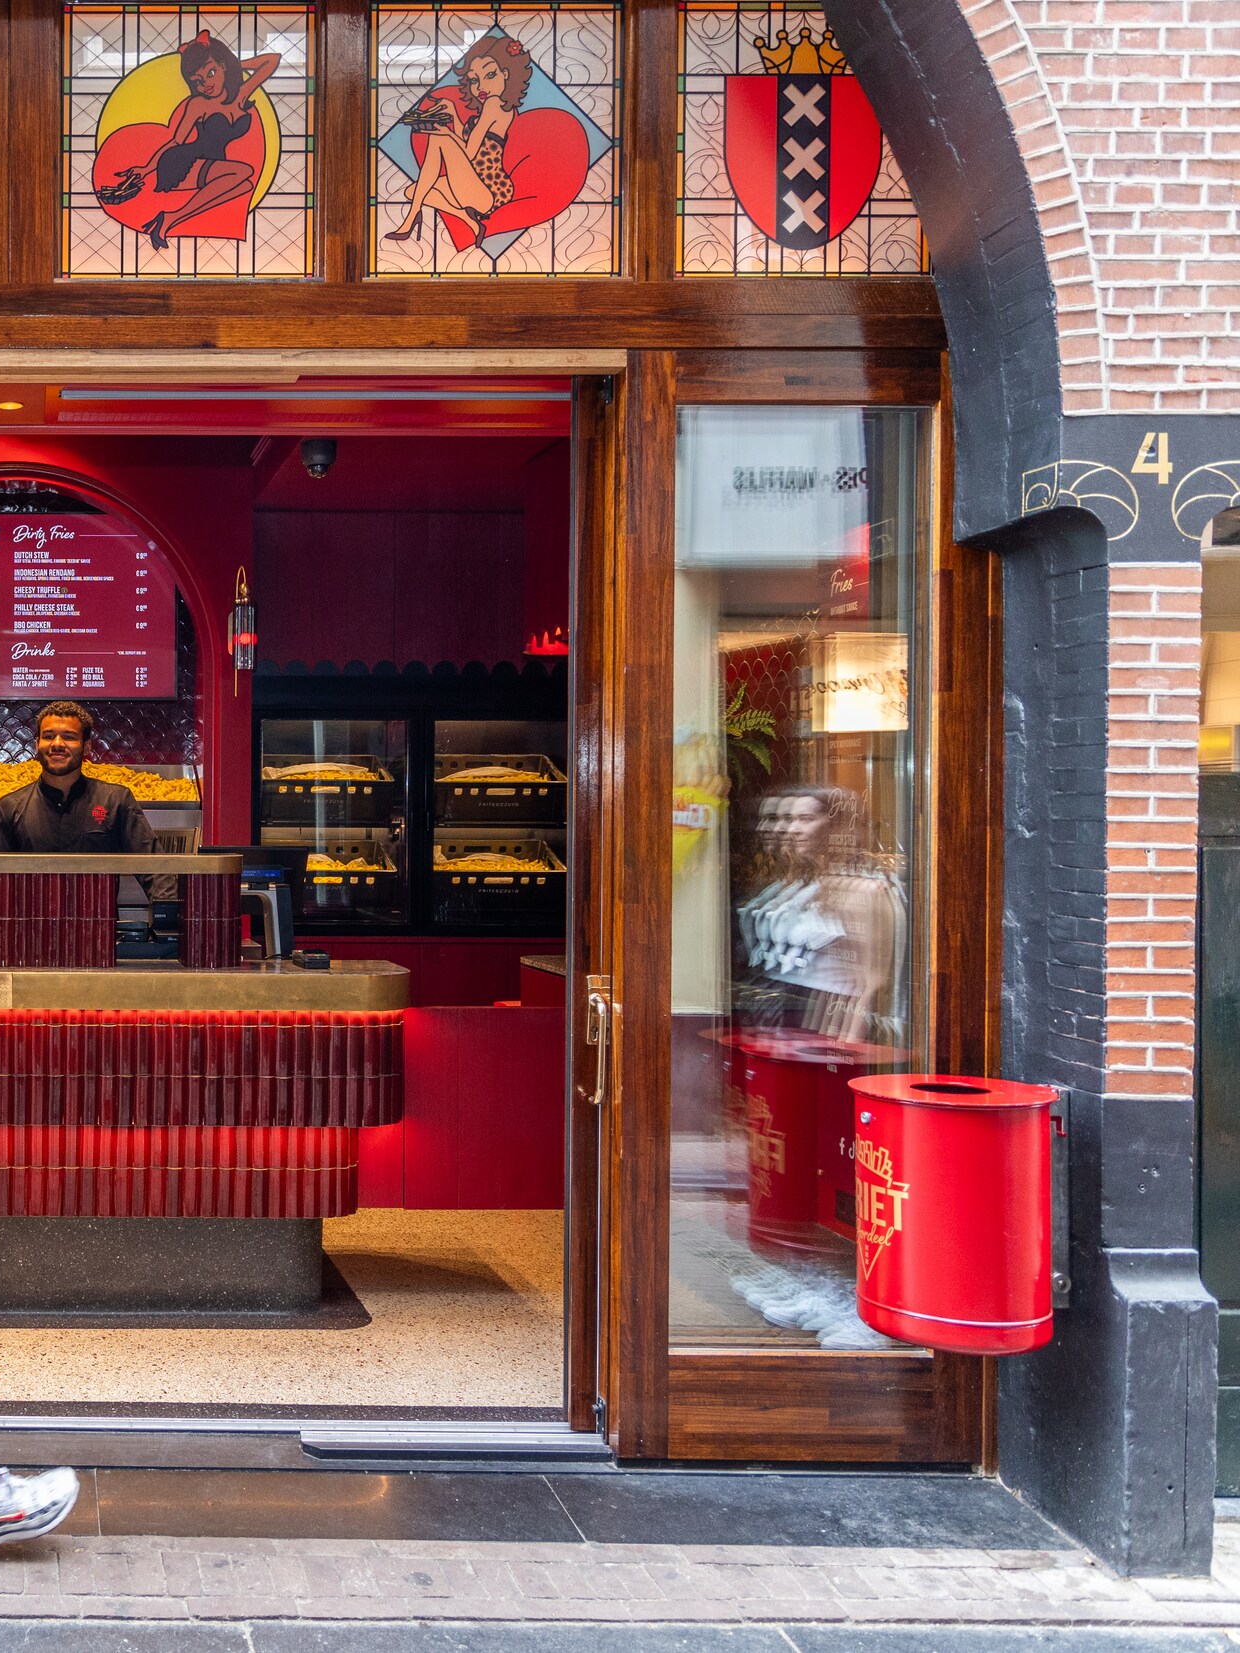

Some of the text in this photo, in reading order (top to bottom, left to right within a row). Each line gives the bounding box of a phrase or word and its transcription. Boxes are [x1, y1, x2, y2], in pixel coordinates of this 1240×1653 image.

[1131, 432, 1173, 484] 4
[13, 525, 75, 549] Dirty Fries
[829, 568, 854, 598] Fries
[11, 642, 55, 660] Drinks
[828, 788, 858, 830] Dirty
[856, 1177, 908, 1231] RIET
